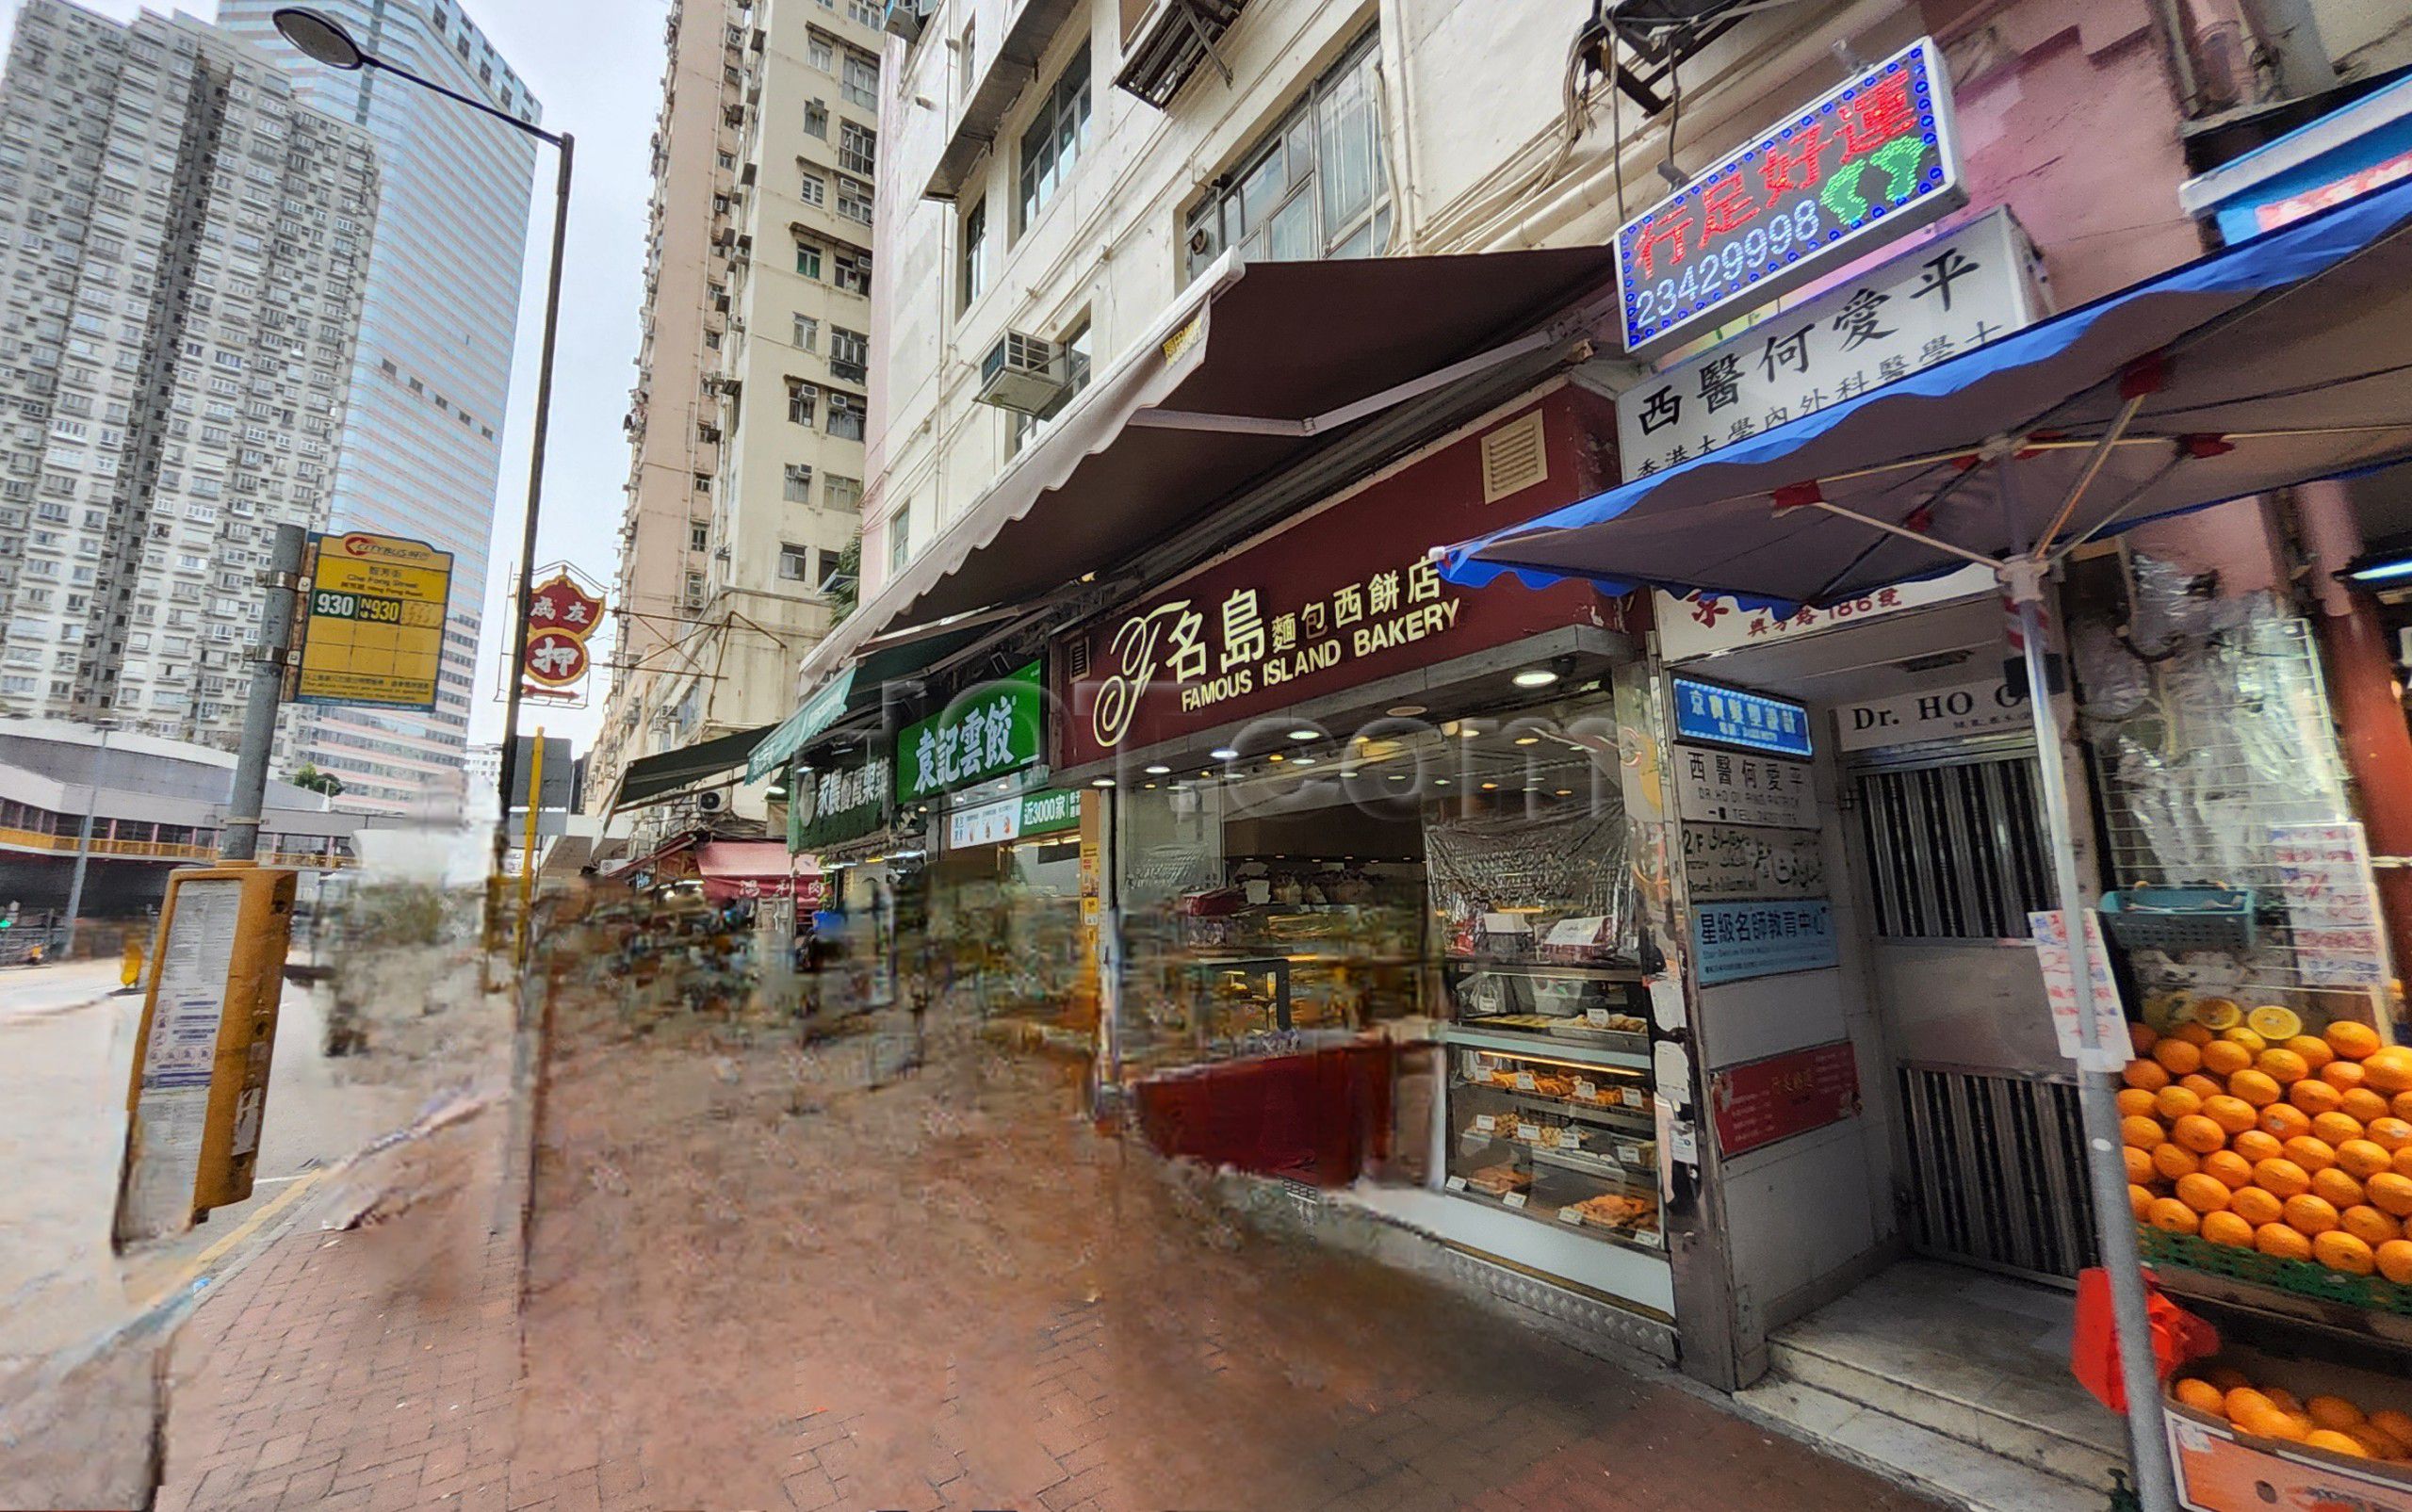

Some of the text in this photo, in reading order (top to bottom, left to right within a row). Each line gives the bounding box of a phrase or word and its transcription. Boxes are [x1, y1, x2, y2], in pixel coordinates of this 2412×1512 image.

[1635, 68, 1919, 280] 行足好運
[1635, 199, 1819, 329] 23429998
[1638, 247, 1981, 435] 西醫何愛平
[317, 593, 355, 618] 930
[360, 597, 400, 624] N930
[531, 636, 579, 677] 押
[1181, 597, 1460, 713] FAMOUS ISLAND BAKERY
[1851, 707, 1900, 731] Dr.
[1915, 691, 1974, 722] HO
[914, 695, 1015, 796] 袁記雲餃
[1687, 751, 1803, 792] 西醫何愛平
[1023, 792, 1066, 826] 近3000家
[1700, 908, 1827, 946] 星級名師教育中心
